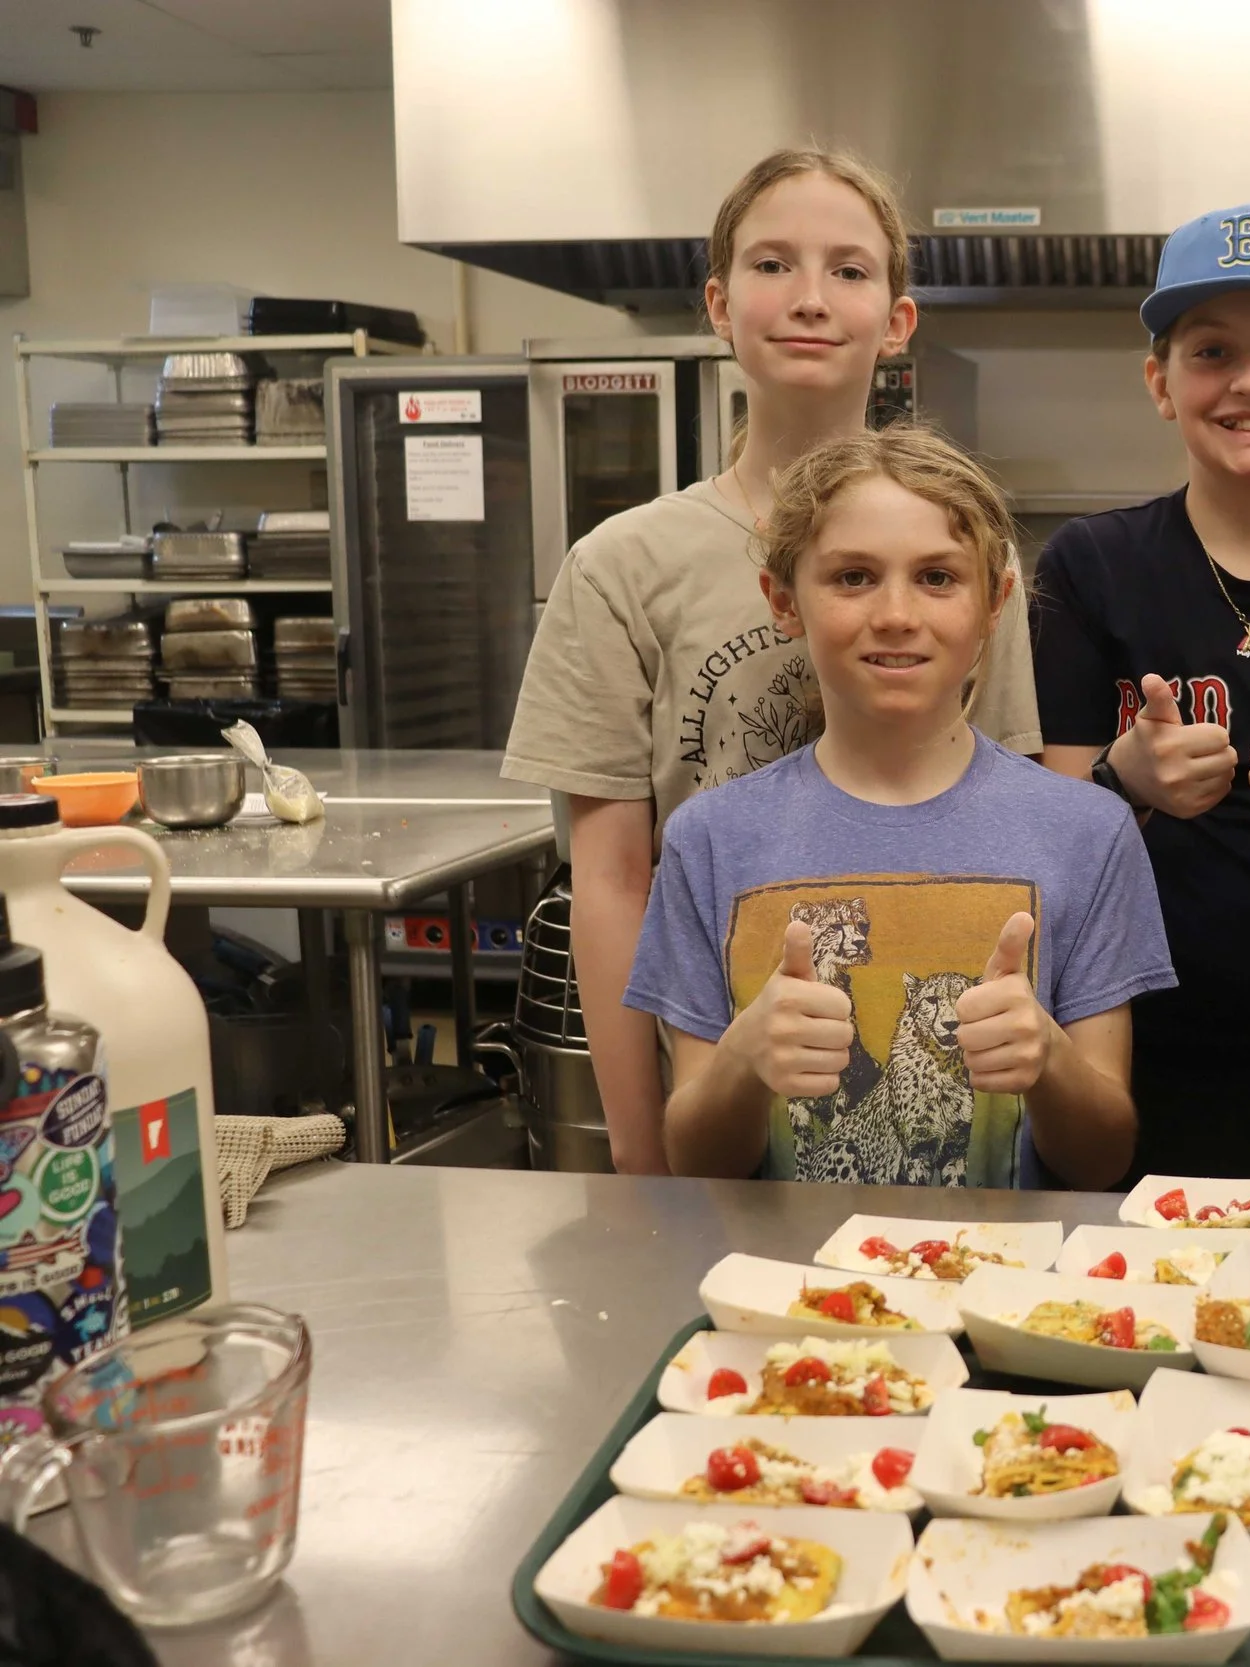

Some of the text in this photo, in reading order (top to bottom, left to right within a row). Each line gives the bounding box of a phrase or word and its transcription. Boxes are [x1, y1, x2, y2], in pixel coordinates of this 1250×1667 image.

[566, 375, 653, 389] BLODGETT
[680, 622, 793, 767] ALL LIGHTS
[1116, 675, 1232, 738] RD
